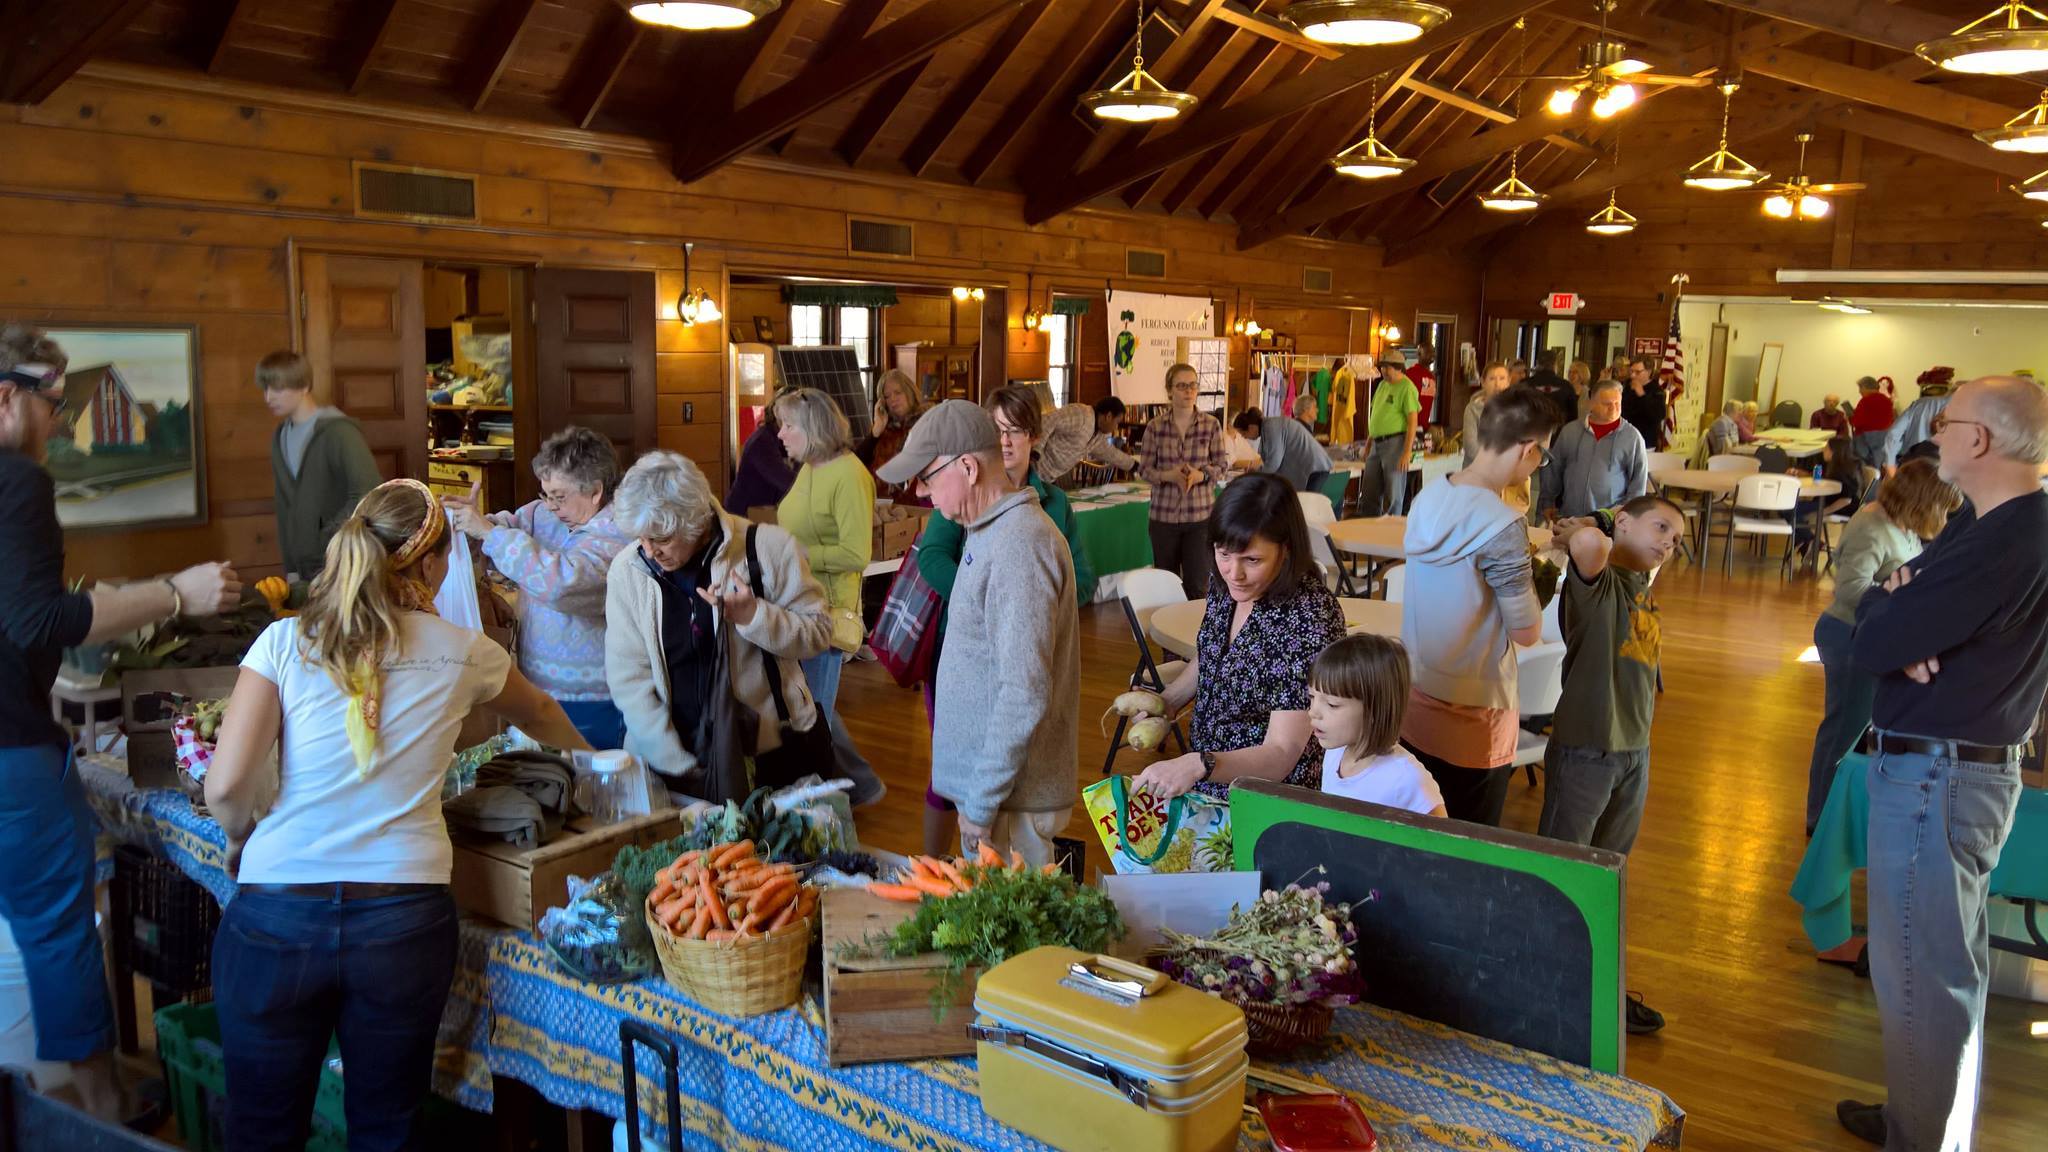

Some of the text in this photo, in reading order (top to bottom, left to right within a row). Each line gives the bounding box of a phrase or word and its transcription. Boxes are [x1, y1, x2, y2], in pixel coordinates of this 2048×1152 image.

[1552, 294, 1573, 309] EXIT
[1141, 319, 1177, 329] FERGUSON
[1114, 803, 1169, 851] OE'S
